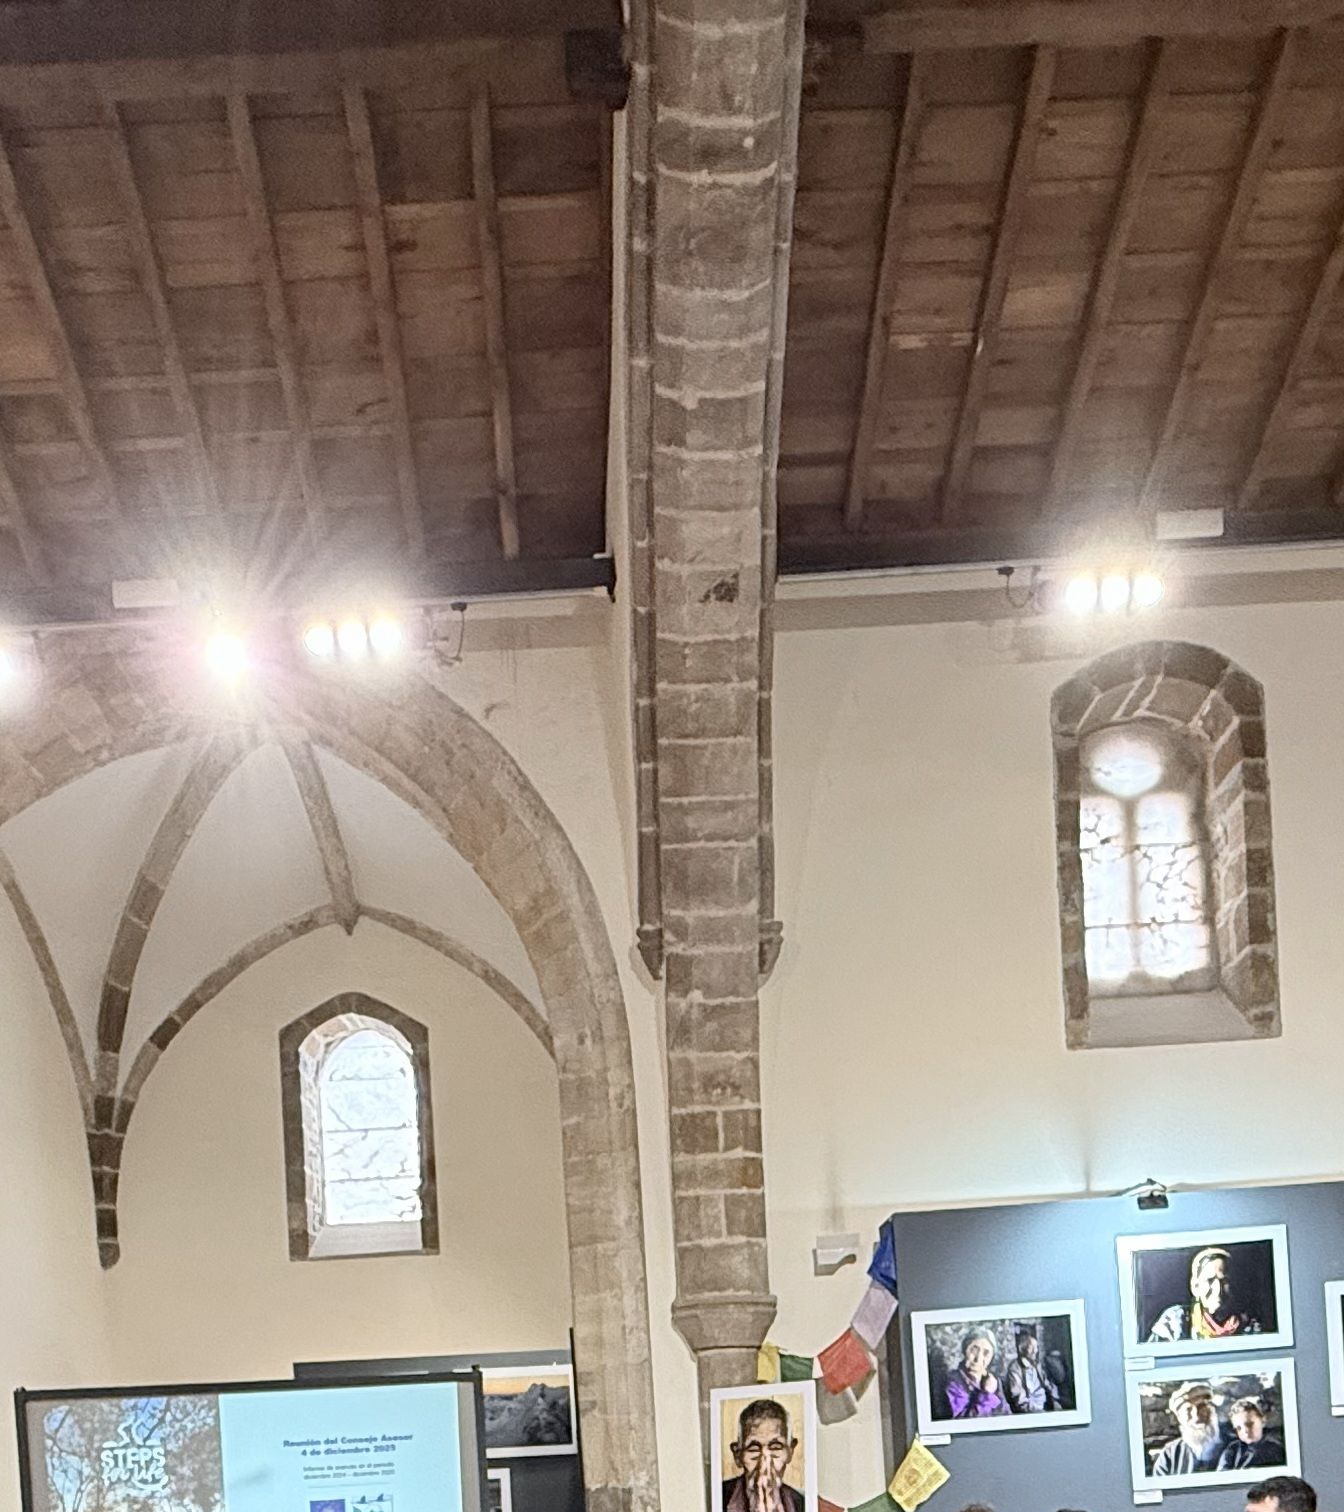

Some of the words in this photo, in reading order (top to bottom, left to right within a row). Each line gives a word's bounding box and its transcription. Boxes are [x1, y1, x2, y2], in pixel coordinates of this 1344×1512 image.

[324, 1437, 338, 1445] del
[341, 1434, 378, 1444] Consejo
[310, 1448, 321, 1456] de
[324, 1447, 370, 1455] diciembre
